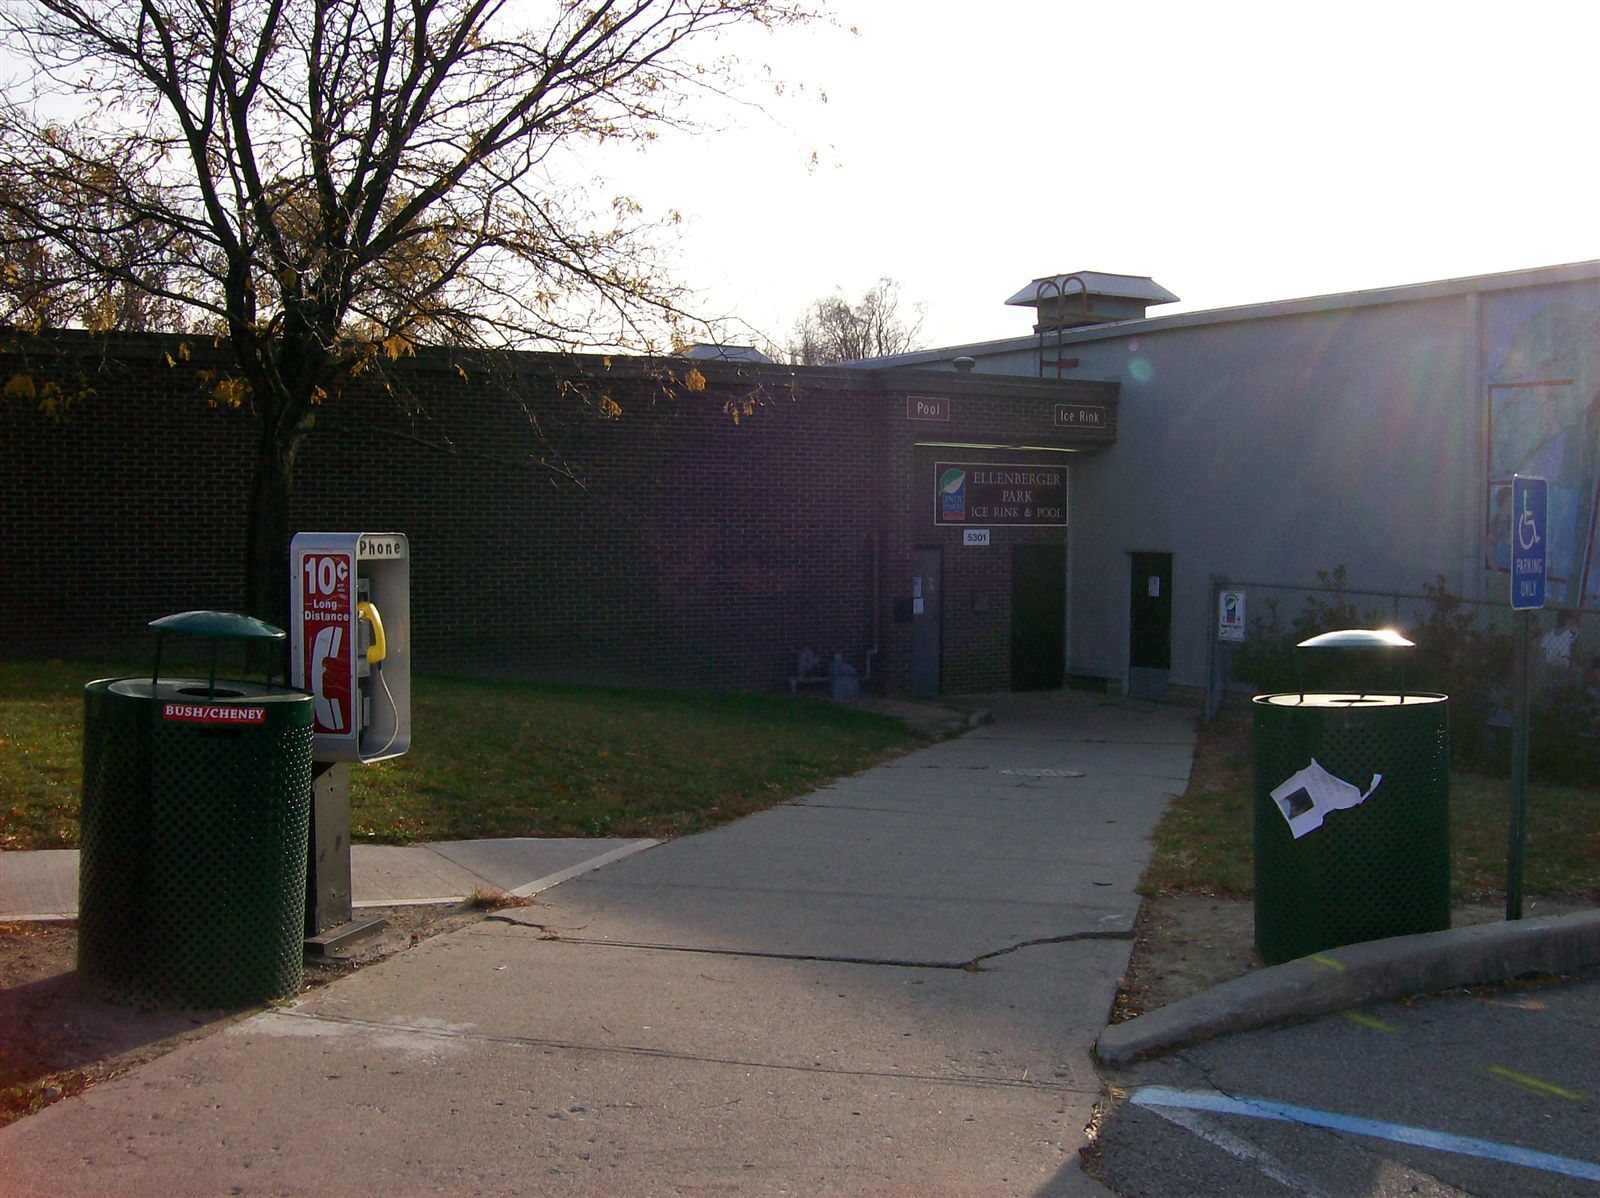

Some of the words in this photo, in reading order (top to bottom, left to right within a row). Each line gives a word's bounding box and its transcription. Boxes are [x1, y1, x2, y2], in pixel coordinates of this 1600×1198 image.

[917, 401, 940, 416] Pool
[1060, 410, 1074, 422] Ice
[1079, 410, 1099, 423] Rink
[973, 471, 1061, 485] ELLENBERGER
[1002, 490, 1032, 502] PARK
[971, 507, 988, 517] ICE
[993, 507, 1019, 518] RINK
[1024, 507, 1032, 517] &
[1037, 507, 1062, 518] POOL
[967, 533, 987, 542] 5301
[360, 541, 400, 556] Phone
[1516, 558, 1542, 575] PARKING
[1520, 580, 1537, 597] ONLY
[313, 599, 338, 610] Long
[304, 610, 349, 621] Distance
[165, 705, 264, 720] BUSH/CHENEY
